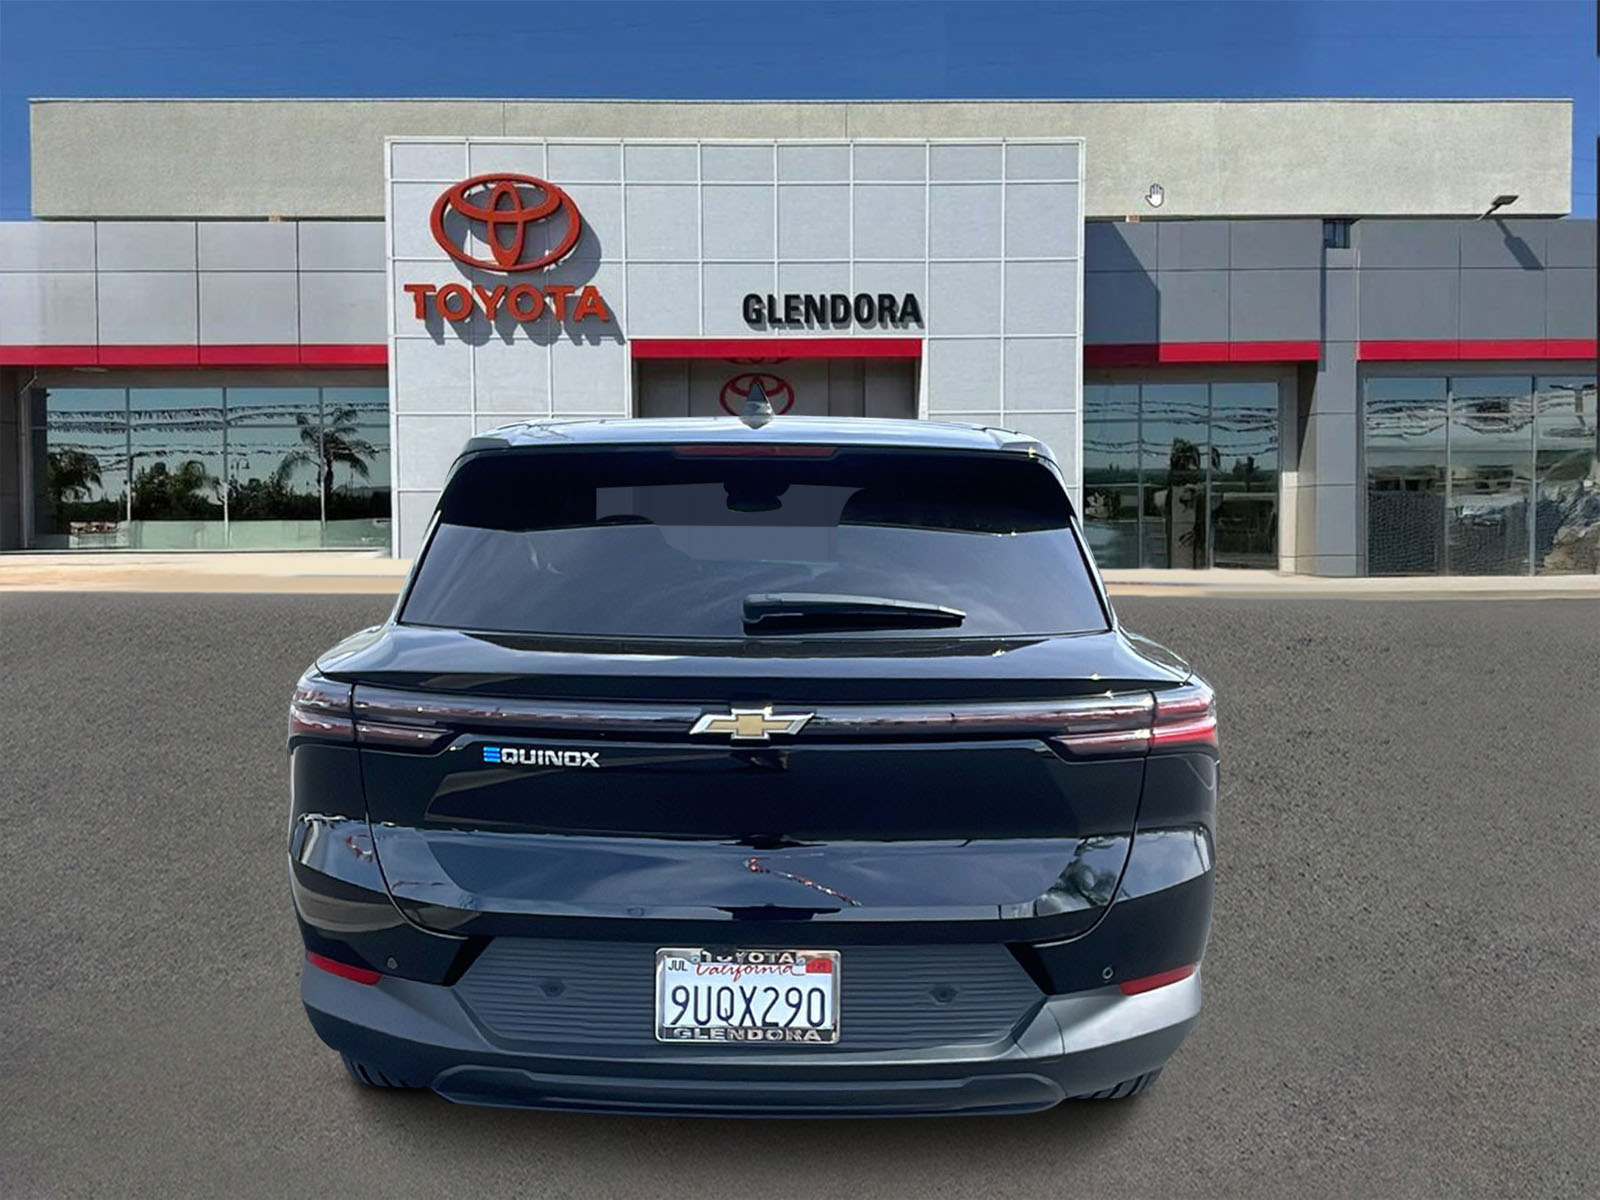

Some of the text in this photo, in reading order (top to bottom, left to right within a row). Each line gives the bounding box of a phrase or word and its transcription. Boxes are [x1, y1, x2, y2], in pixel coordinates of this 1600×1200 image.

[403, 283, 611, 322] TOYOTA
[743, 293, 922, 325] GLENDORA
[483, 746, 600, 768] EQUINOX
[668, 960, 688, 971] JUL
[671, 985, 826, 1027] 9UQX290
[673, 1028, 822, 1041] GLENDORA
